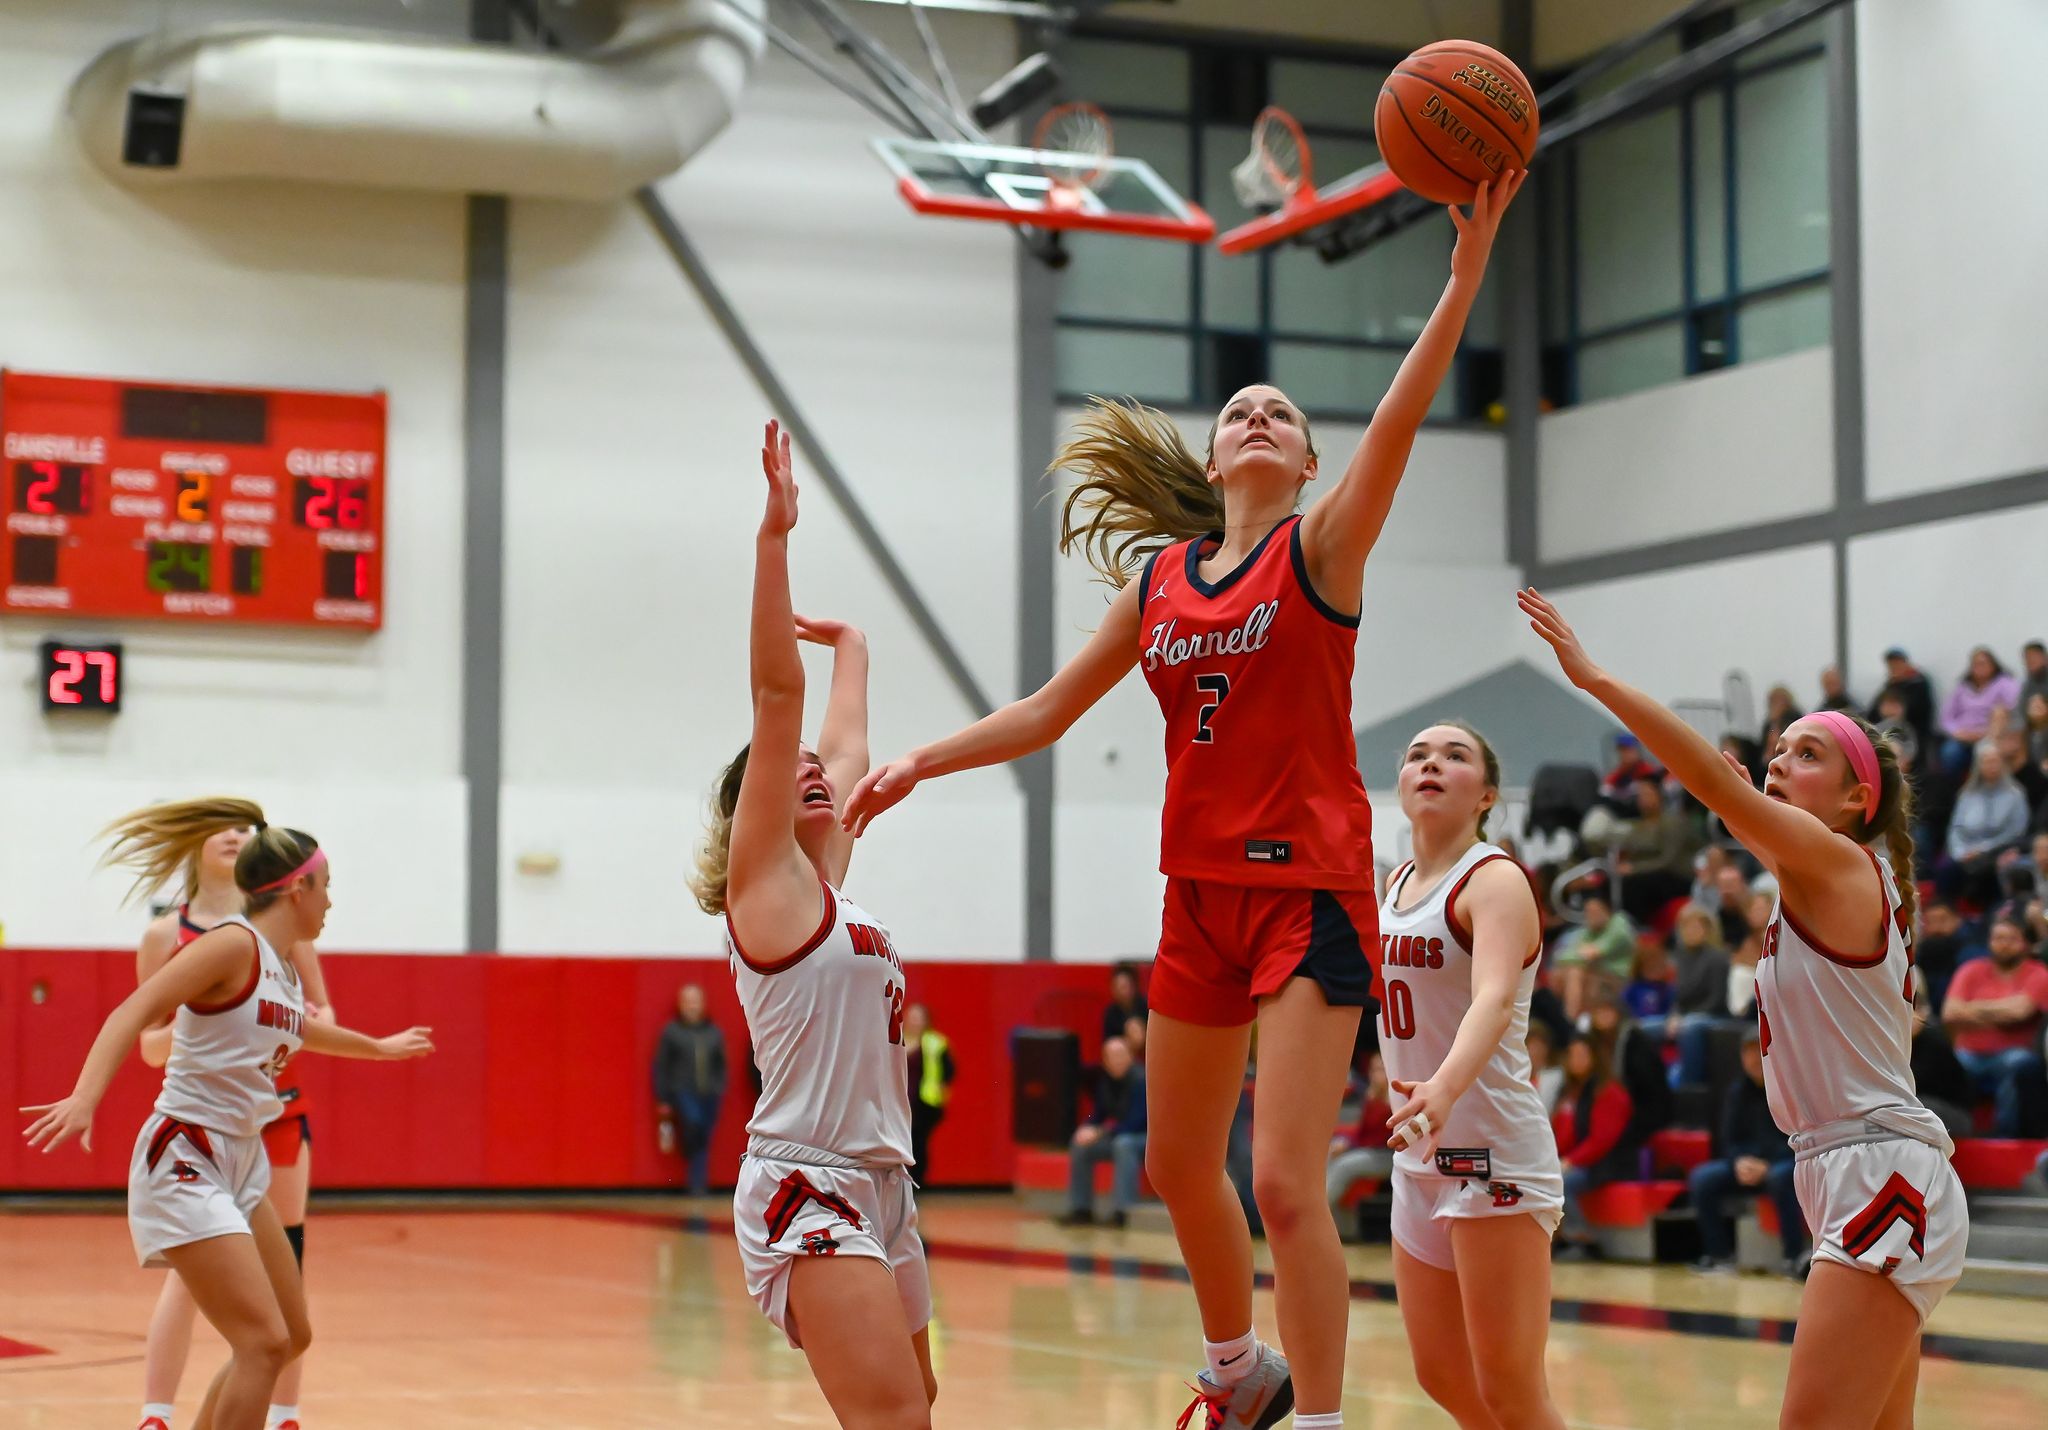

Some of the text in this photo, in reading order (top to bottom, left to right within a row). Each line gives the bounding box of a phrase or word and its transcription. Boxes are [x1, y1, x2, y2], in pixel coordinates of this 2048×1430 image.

[1452, 70, 1529, 135] LEGACY
[27, 461, 90, 514] 21
[286, 449, 376, 478] GUEST
[178, 470, 210, 521] 2
[304, 477, 367, 530] 26
[148, 541, 211, 592] 24
[355, 553, 368, 597] 1
[1145, 599, 1279, 672] Hornell
[50, 650, 116, 703] 27
[1192, 672, 1231, 744] 2
[1276, 847, 1285, 857] M
